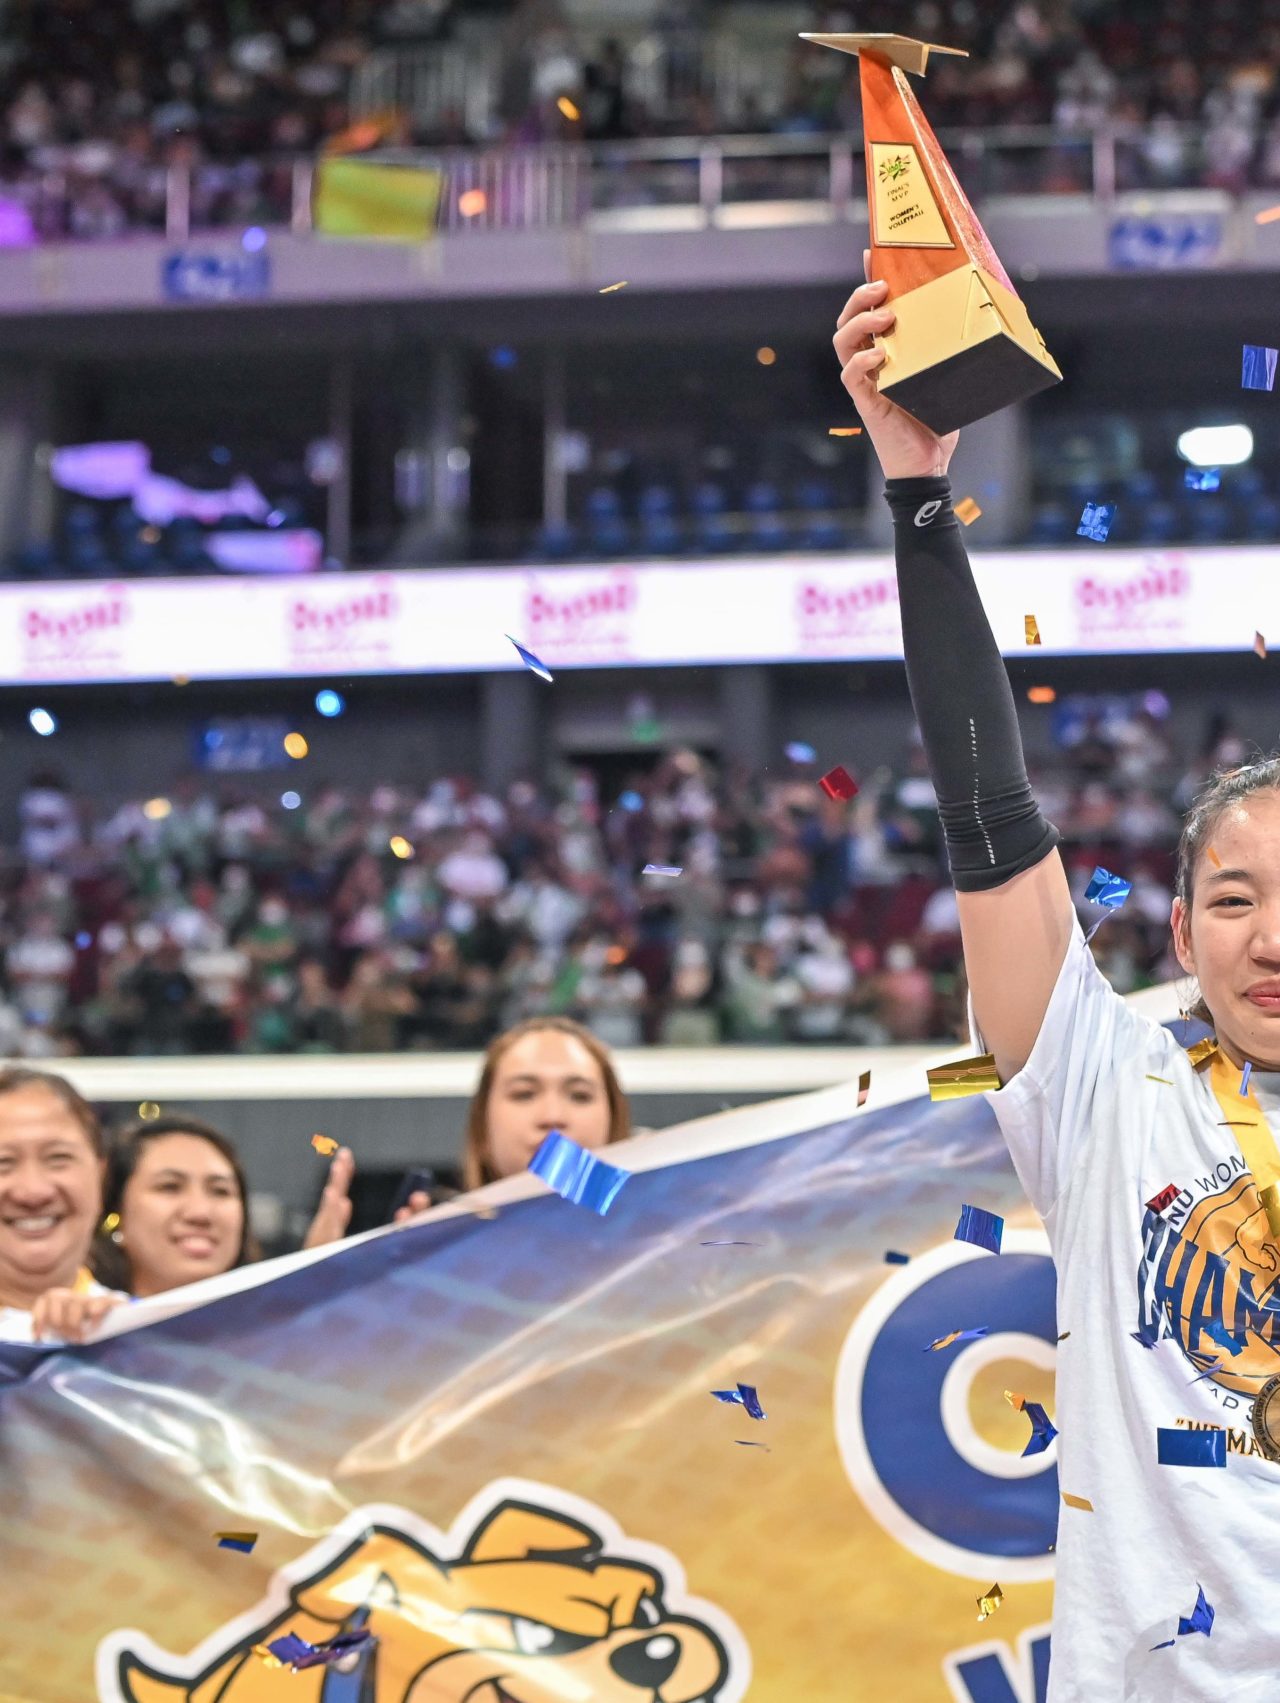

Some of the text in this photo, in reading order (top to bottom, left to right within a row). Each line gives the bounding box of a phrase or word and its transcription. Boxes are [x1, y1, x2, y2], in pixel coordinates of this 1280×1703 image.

[888, 209, 924, 230] VOLLEYBALL
[889, 203, 919, 222] WOMEN'S
[1167, 1188, 1194, 1226] NU
